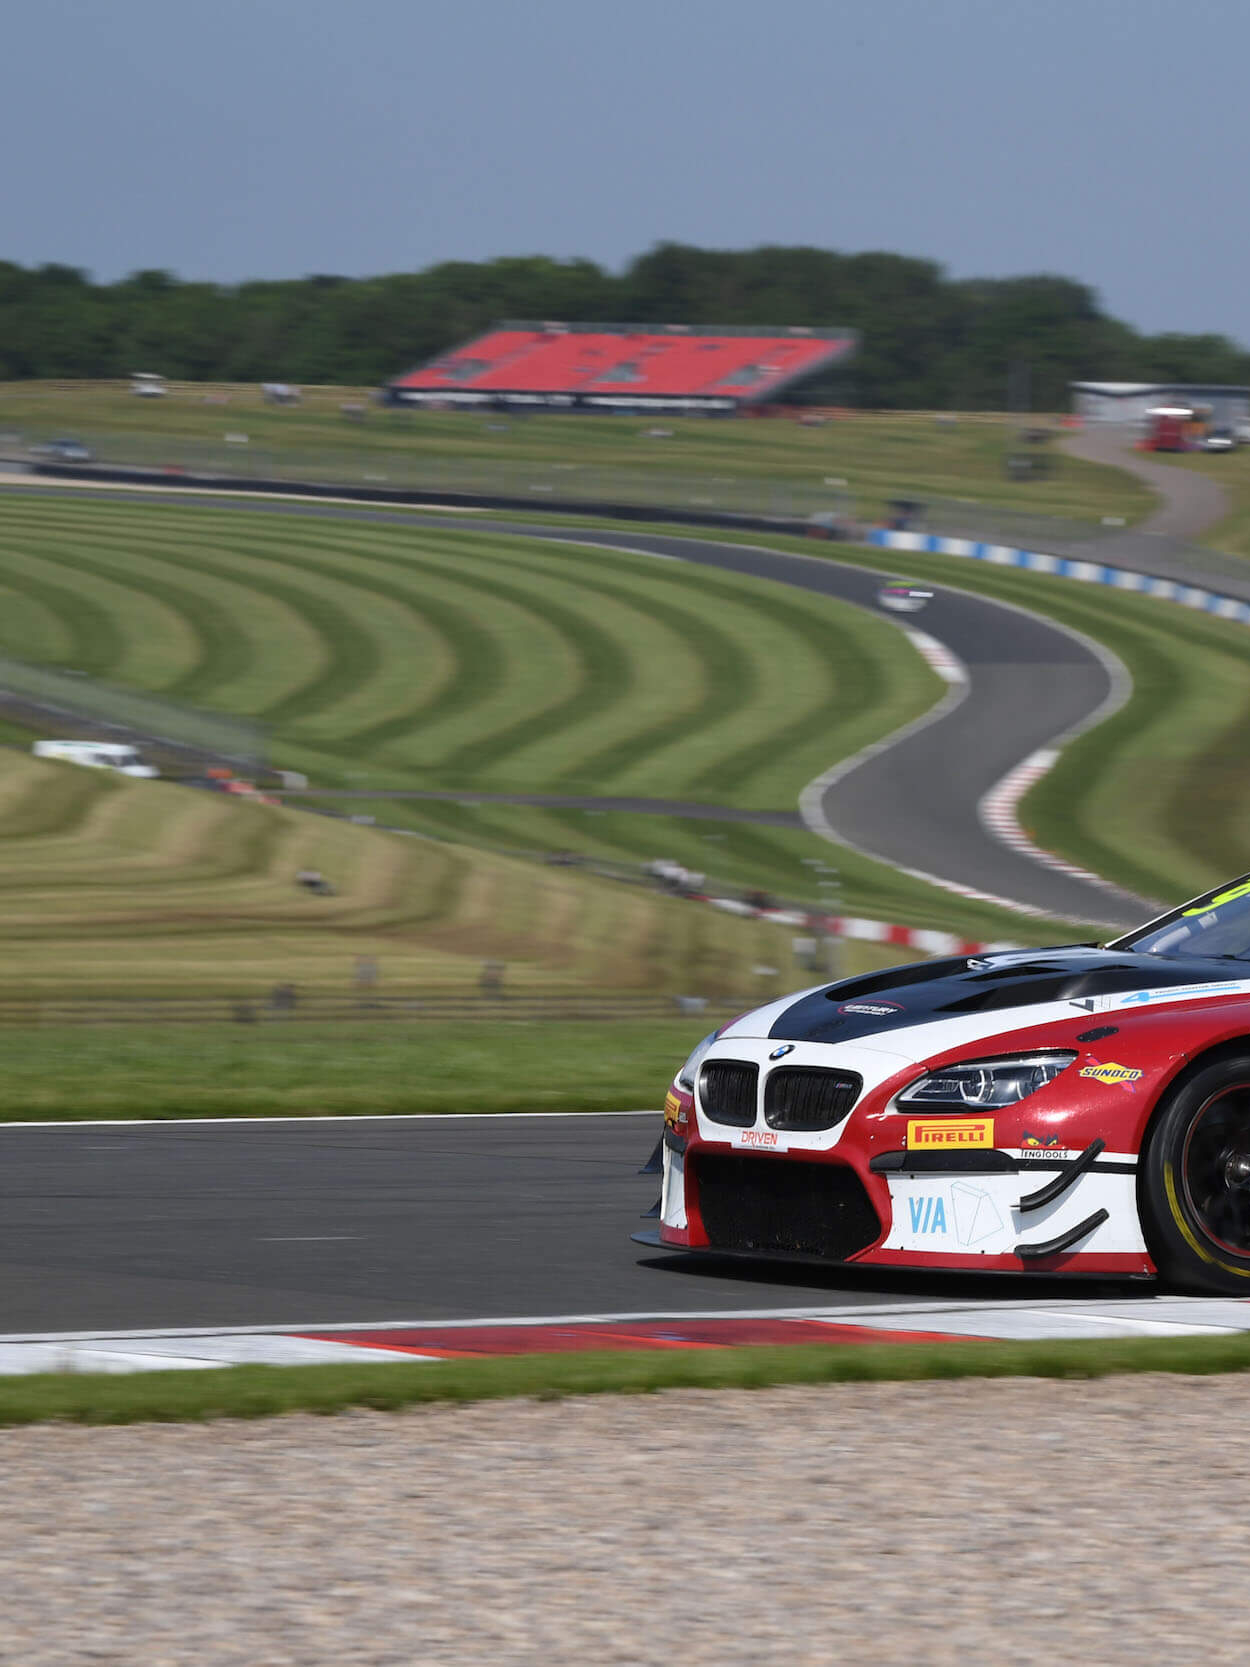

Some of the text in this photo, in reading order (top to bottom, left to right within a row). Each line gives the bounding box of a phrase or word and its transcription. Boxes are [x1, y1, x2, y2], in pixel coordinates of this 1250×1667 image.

[1080, 1067, 1141, 1080] SUNOCO
[741, 1131, 778, 1147] DRIVEN
[915, 1124, 986, 1143] PIRELLI
[908, 1197, 947, 1233] VIA
